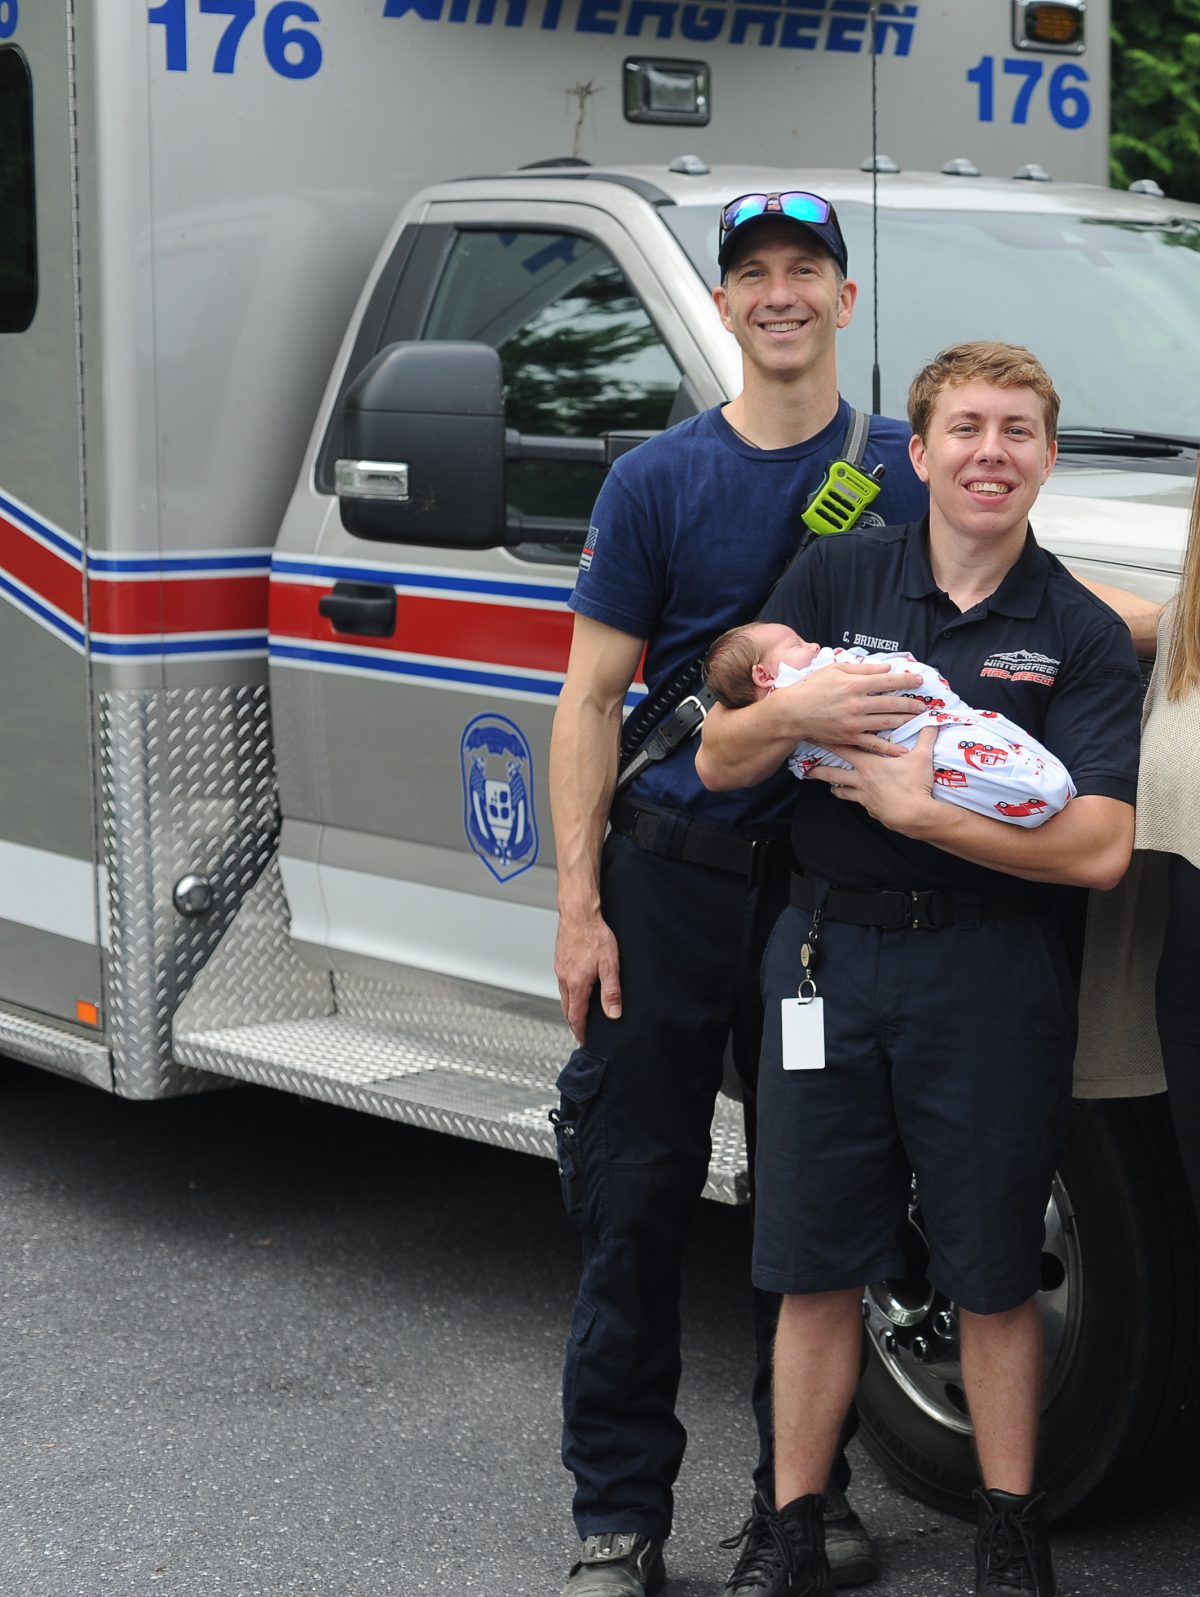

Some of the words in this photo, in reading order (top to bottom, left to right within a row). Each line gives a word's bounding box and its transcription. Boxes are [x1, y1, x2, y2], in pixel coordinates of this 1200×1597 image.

[148, 0, 323, 80] 176
[967, 56, 1091, 130] 176
[853, 634, 899, 651] BRINKER
[984, 659, 1058, 675] WINTERGREEN
